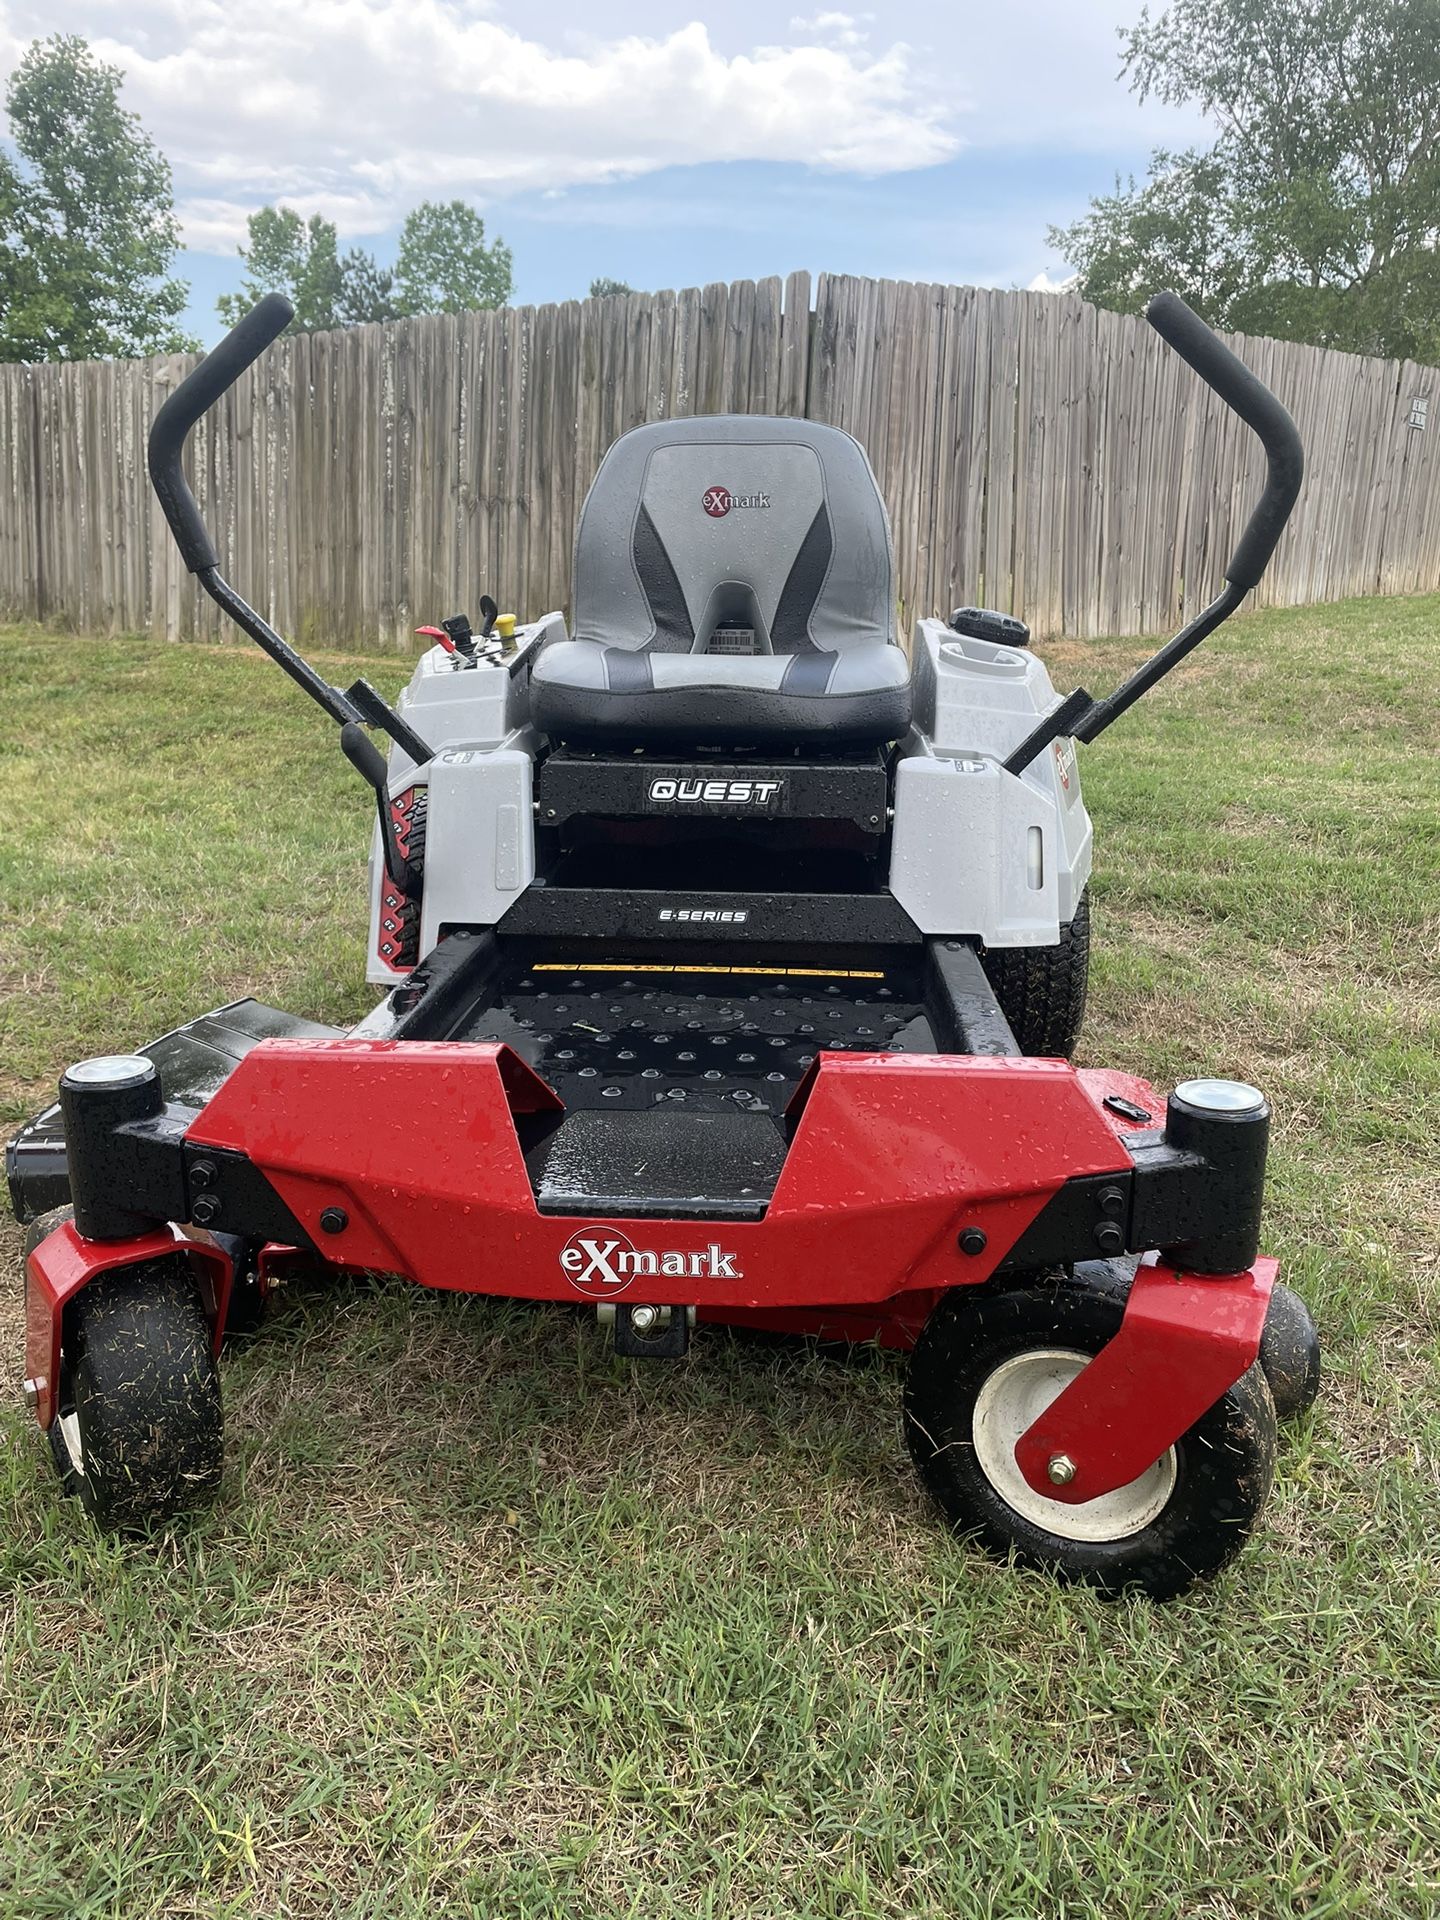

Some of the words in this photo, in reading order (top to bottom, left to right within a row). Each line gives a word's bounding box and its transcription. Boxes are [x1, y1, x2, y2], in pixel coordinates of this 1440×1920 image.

[702, 491, 770, 512] eXmark
[650, 779, 781, 803] QUEST
[658, 909, 748, 923] E-SERIES
[559, 1239, 744, 1284] eXmark
